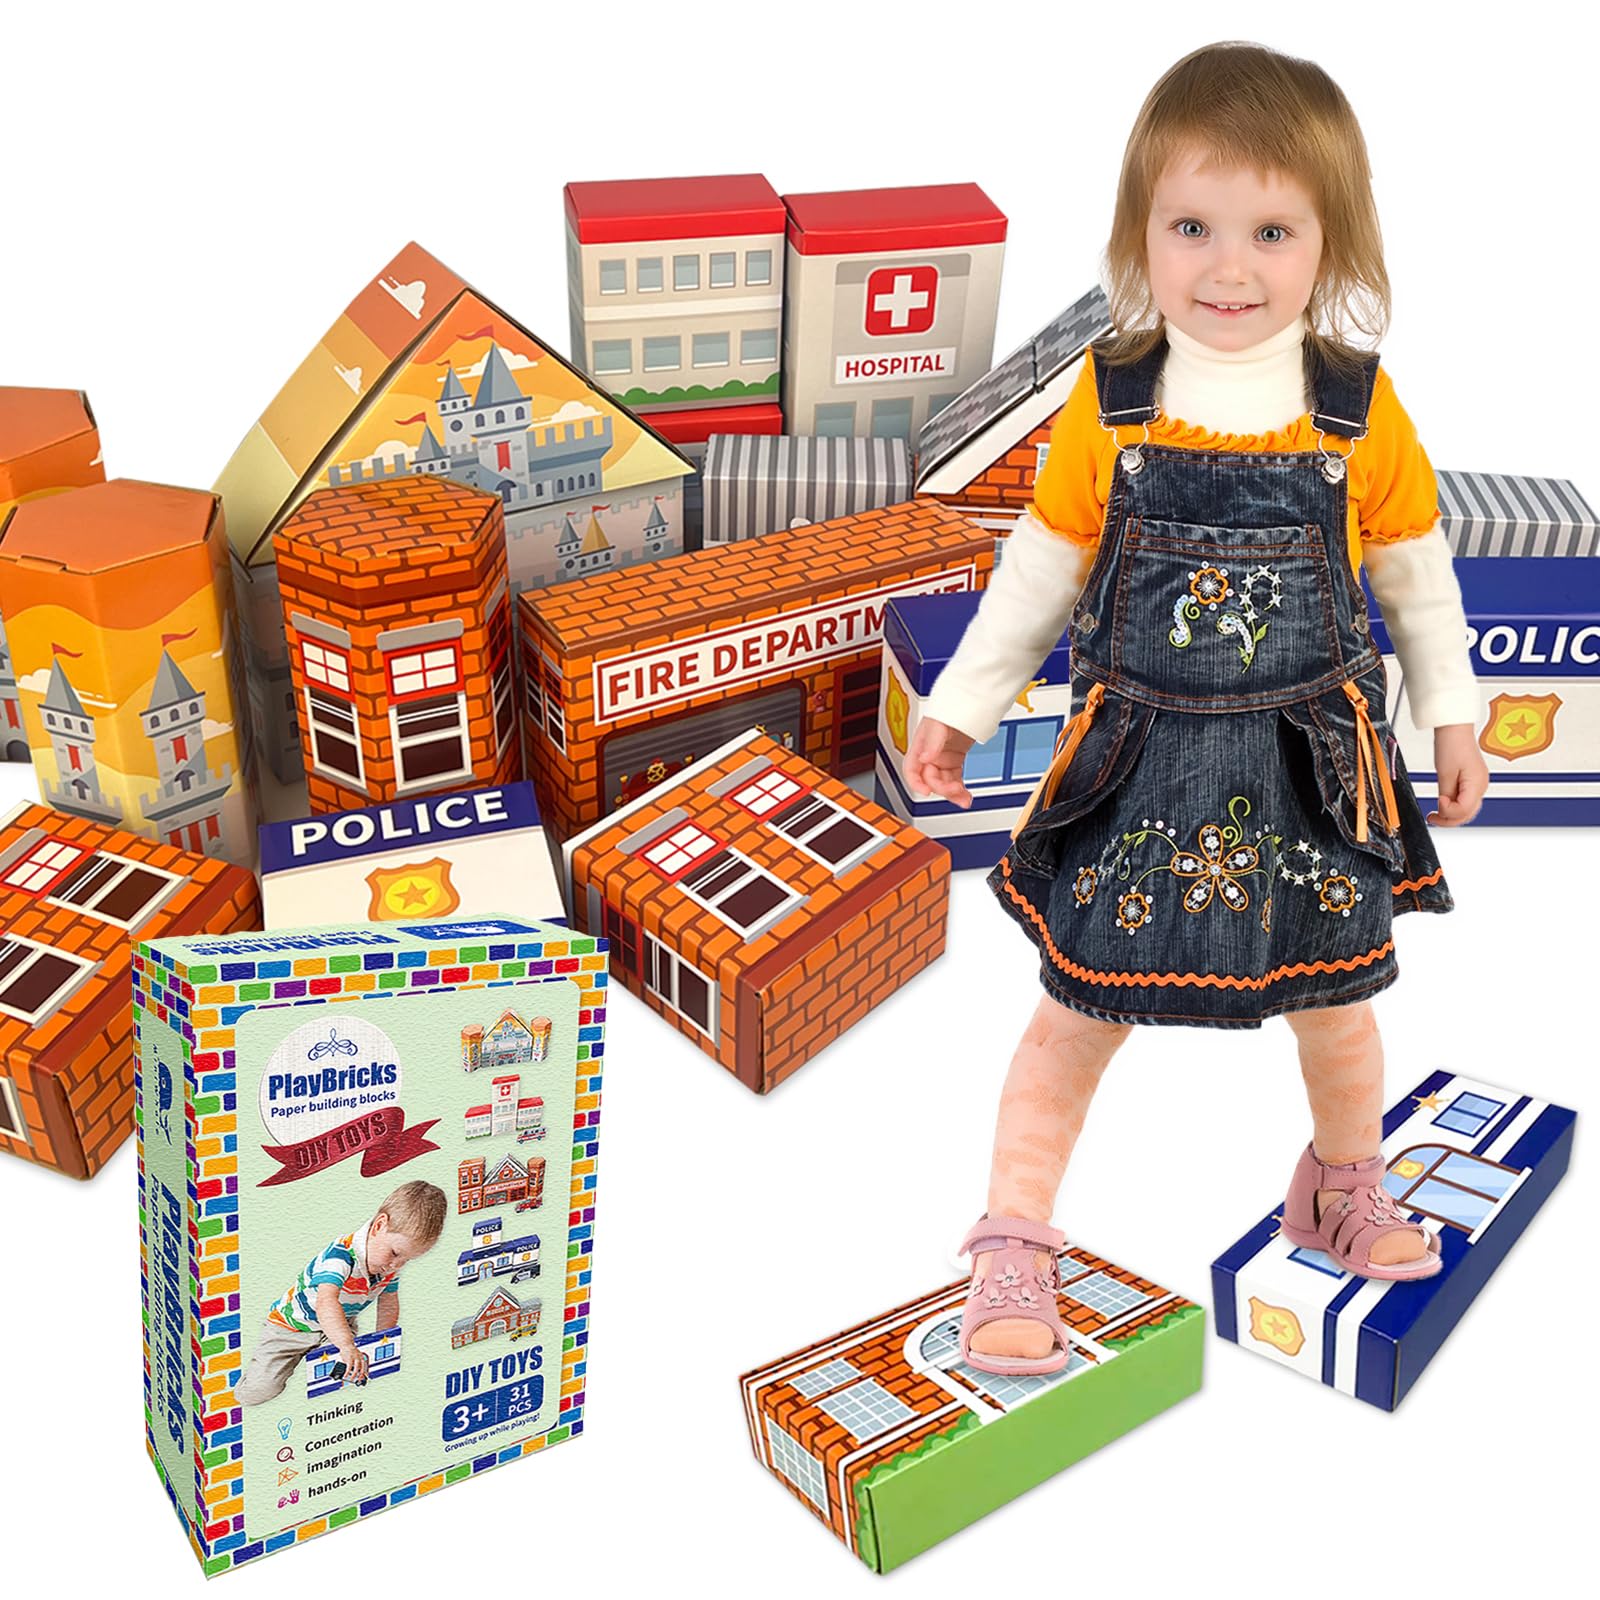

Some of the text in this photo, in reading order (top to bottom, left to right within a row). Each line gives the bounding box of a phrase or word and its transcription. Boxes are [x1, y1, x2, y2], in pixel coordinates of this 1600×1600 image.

[845, 354, 945, 378] HOSPITAL
[609, 582, 965, 706] FIRE DEPARTM
[291, 790, 508, 856] POLICE
[269, 1062, 397, 1101] PlayBricks
[271, 1090, 396, 1118] Paper building blocks
[294, 1112, 388, 1169] DIY TOYS
[476, 1224, 499, 1235] POLICE
[161, 1181, 187, 1455] PlayBricks
[445, 1344, 543, 1399] DIY TOYS
[510, 1383, 531, 1402] 31
[306, 1401, 364, 1426] Thinking
[452, 1403, 490, 1433] 3+
[508, 1399, 532, 1417] PCS
[304, 1416, 394, 1453] Concentration
[444, 1437, 477, 1453] Growing
[478, 1433, 489, 1442] up
[489, 1424, 510, 1437] while
[306, 1441, 382, 1475] imagination
[308, 1470, 367, 1498] hands-on
